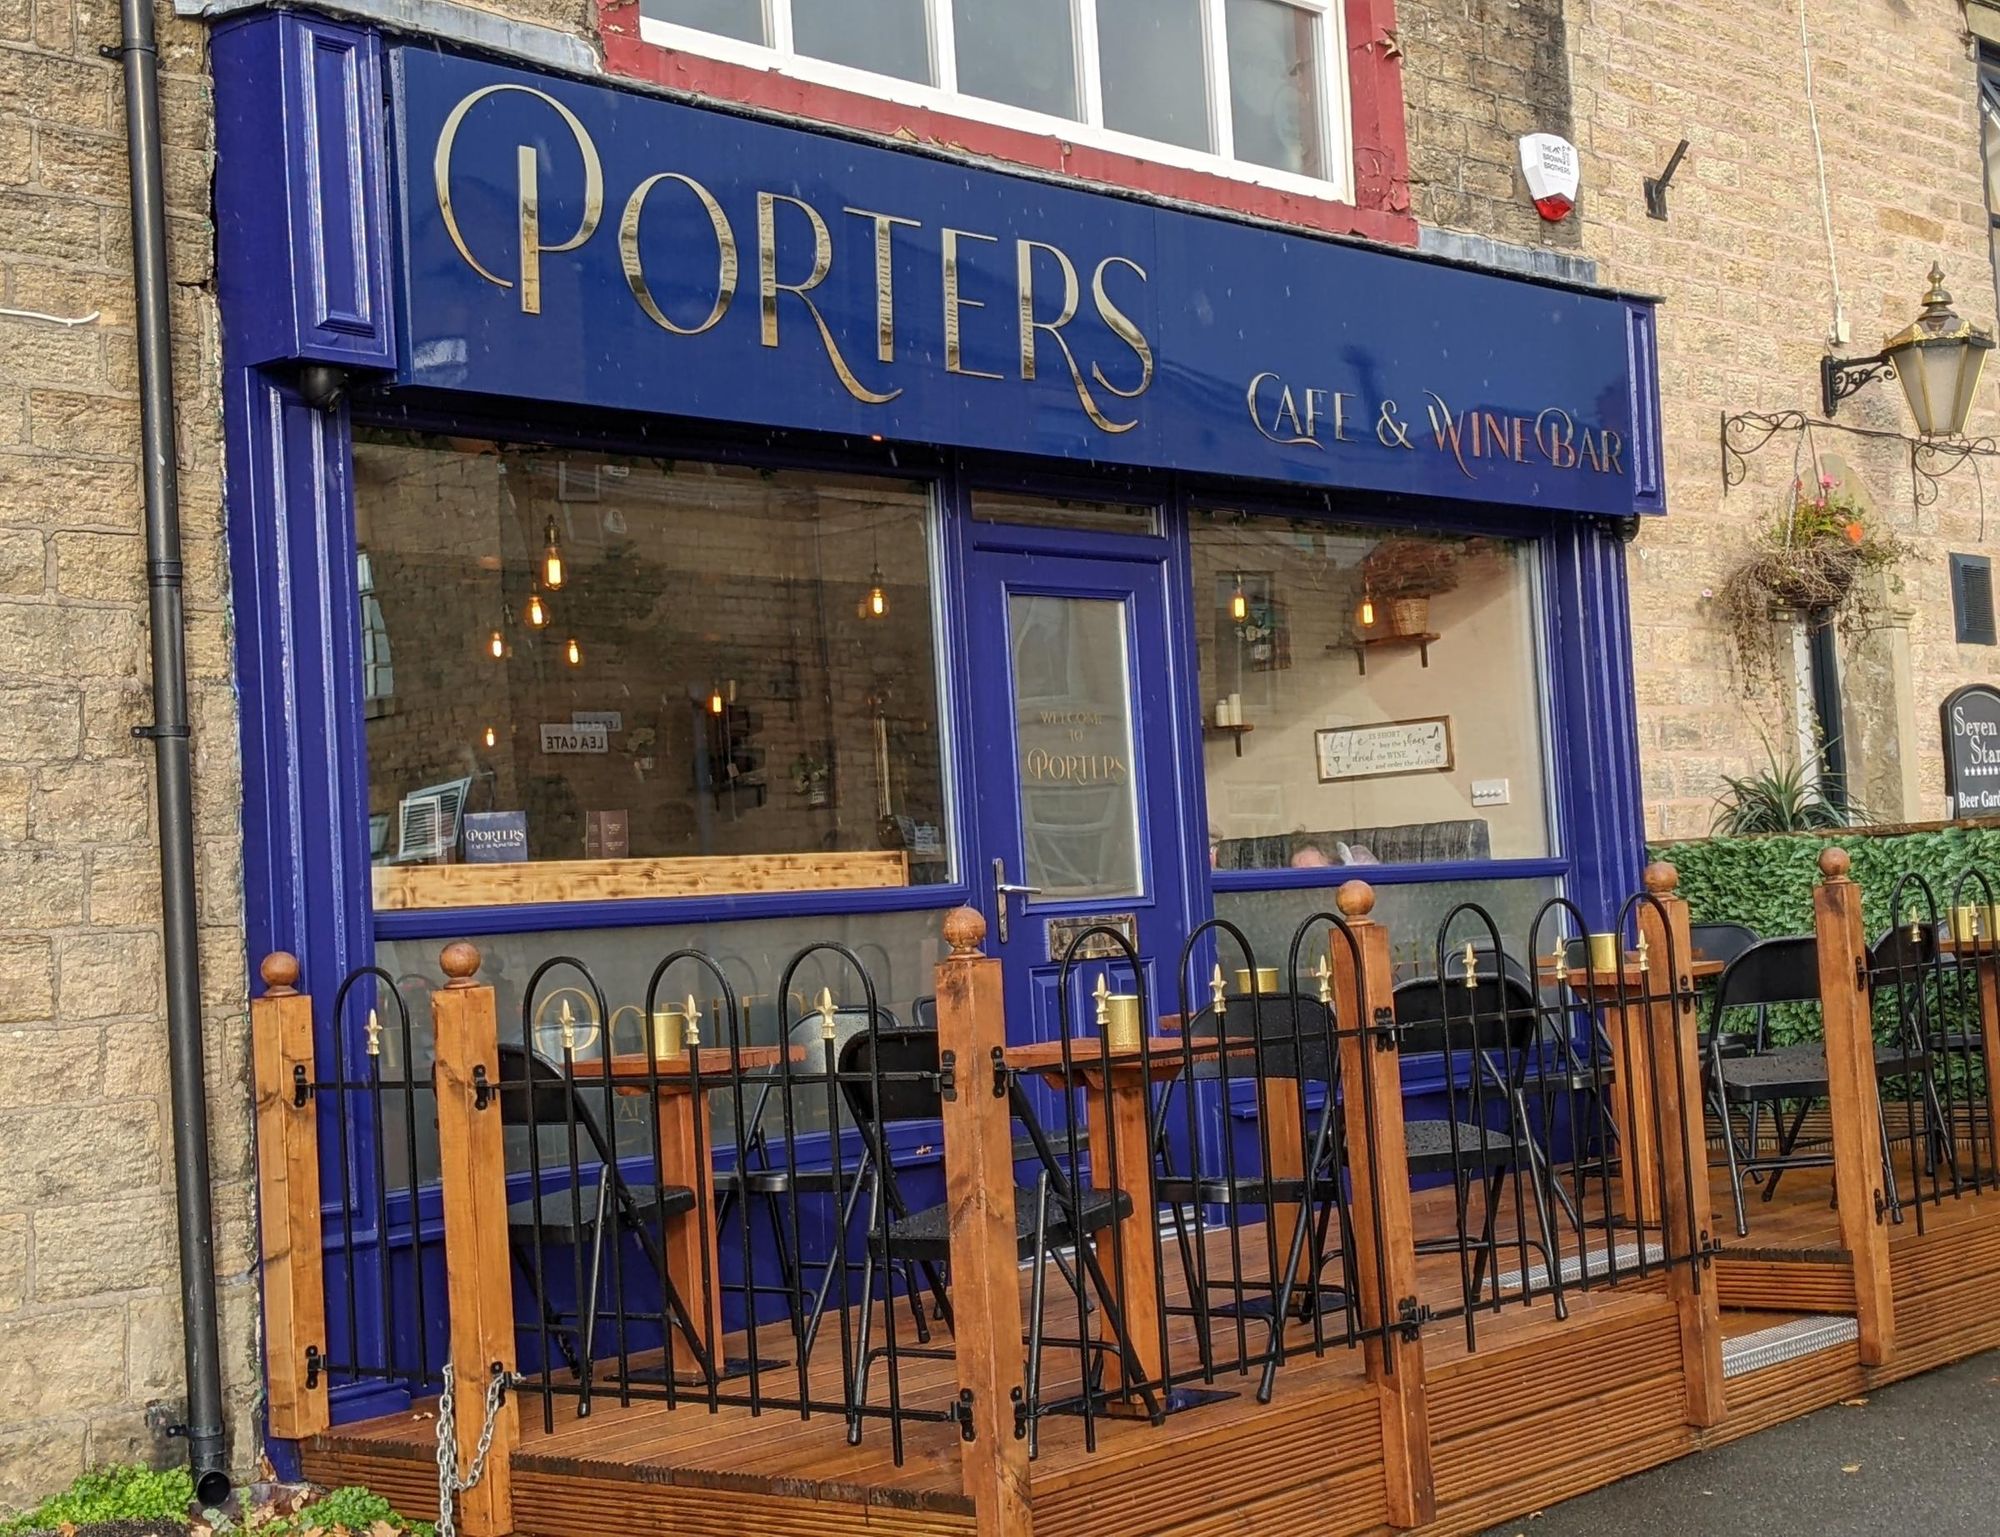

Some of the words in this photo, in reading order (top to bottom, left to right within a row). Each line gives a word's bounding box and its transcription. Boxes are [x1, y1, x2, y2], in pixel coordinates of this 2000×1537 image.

[433, 83, 1155, 434] PORTERS
[1246, 372, 1359, 451] CAFE
[1375, 399, 1415, 450] &
[1421, 387, 1536, 481] WINE
[1534, 407, 1623, 475] BAR
[1953, 706, 1998, 736] Seven
[1028, 747, 1126, 785] PORTERS
[1959, 792, 1979, 809] Beer
[466, 829, 524, 843] PORTERS
